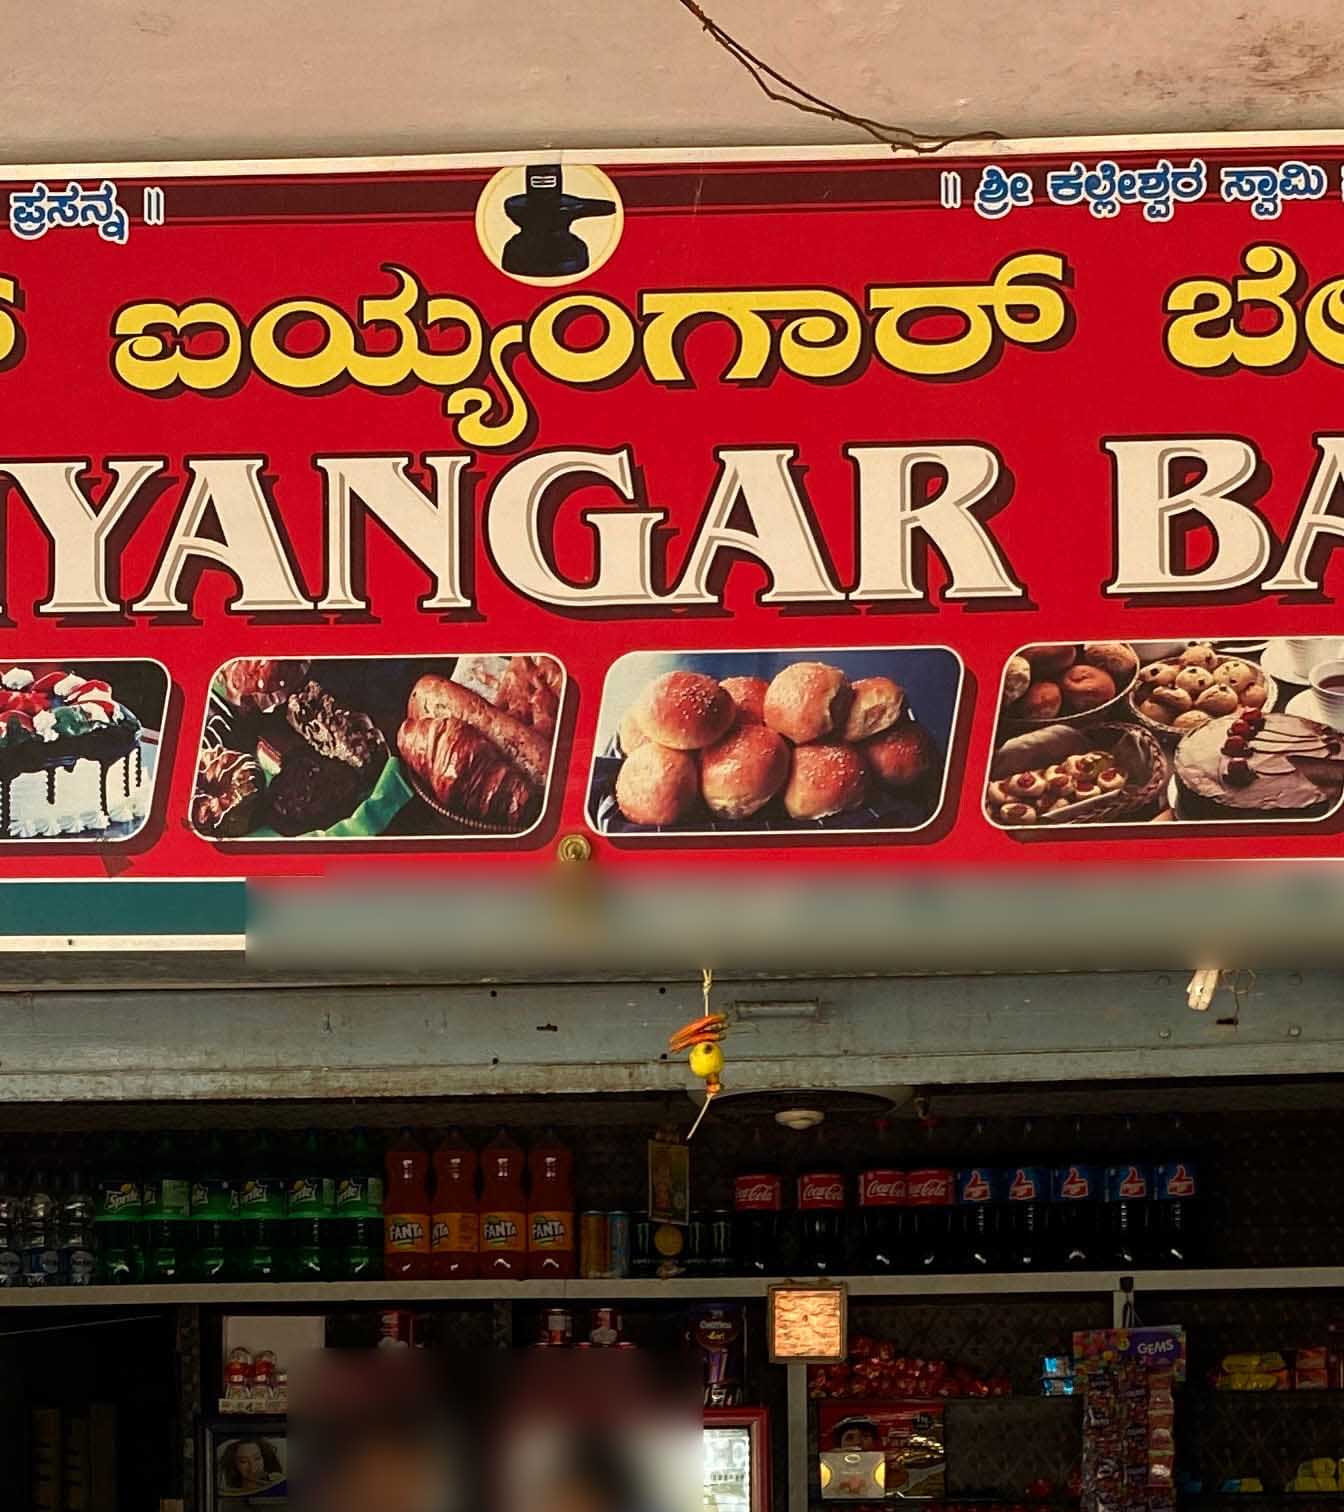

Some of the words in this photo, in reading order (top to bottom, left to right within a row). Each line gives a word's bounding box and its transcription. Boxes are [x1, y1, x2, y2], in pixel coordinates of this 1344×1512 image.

[10, 181, 129, 244] ಪ್ರಸನ್ನ
[975, 165, 1033, 218] ಶ್ರೀ
[1048, 159, 1206, 223] ಕಲ್ಲೇಶ್ವರ
[1220, 159, 1326, 219] ಸ್ವಾಮಿ
[113, 253, 1068, 448] ಐಯ್ಯಂಗಾರ್
[1136, 1338, 1175, 1356] GEMS
